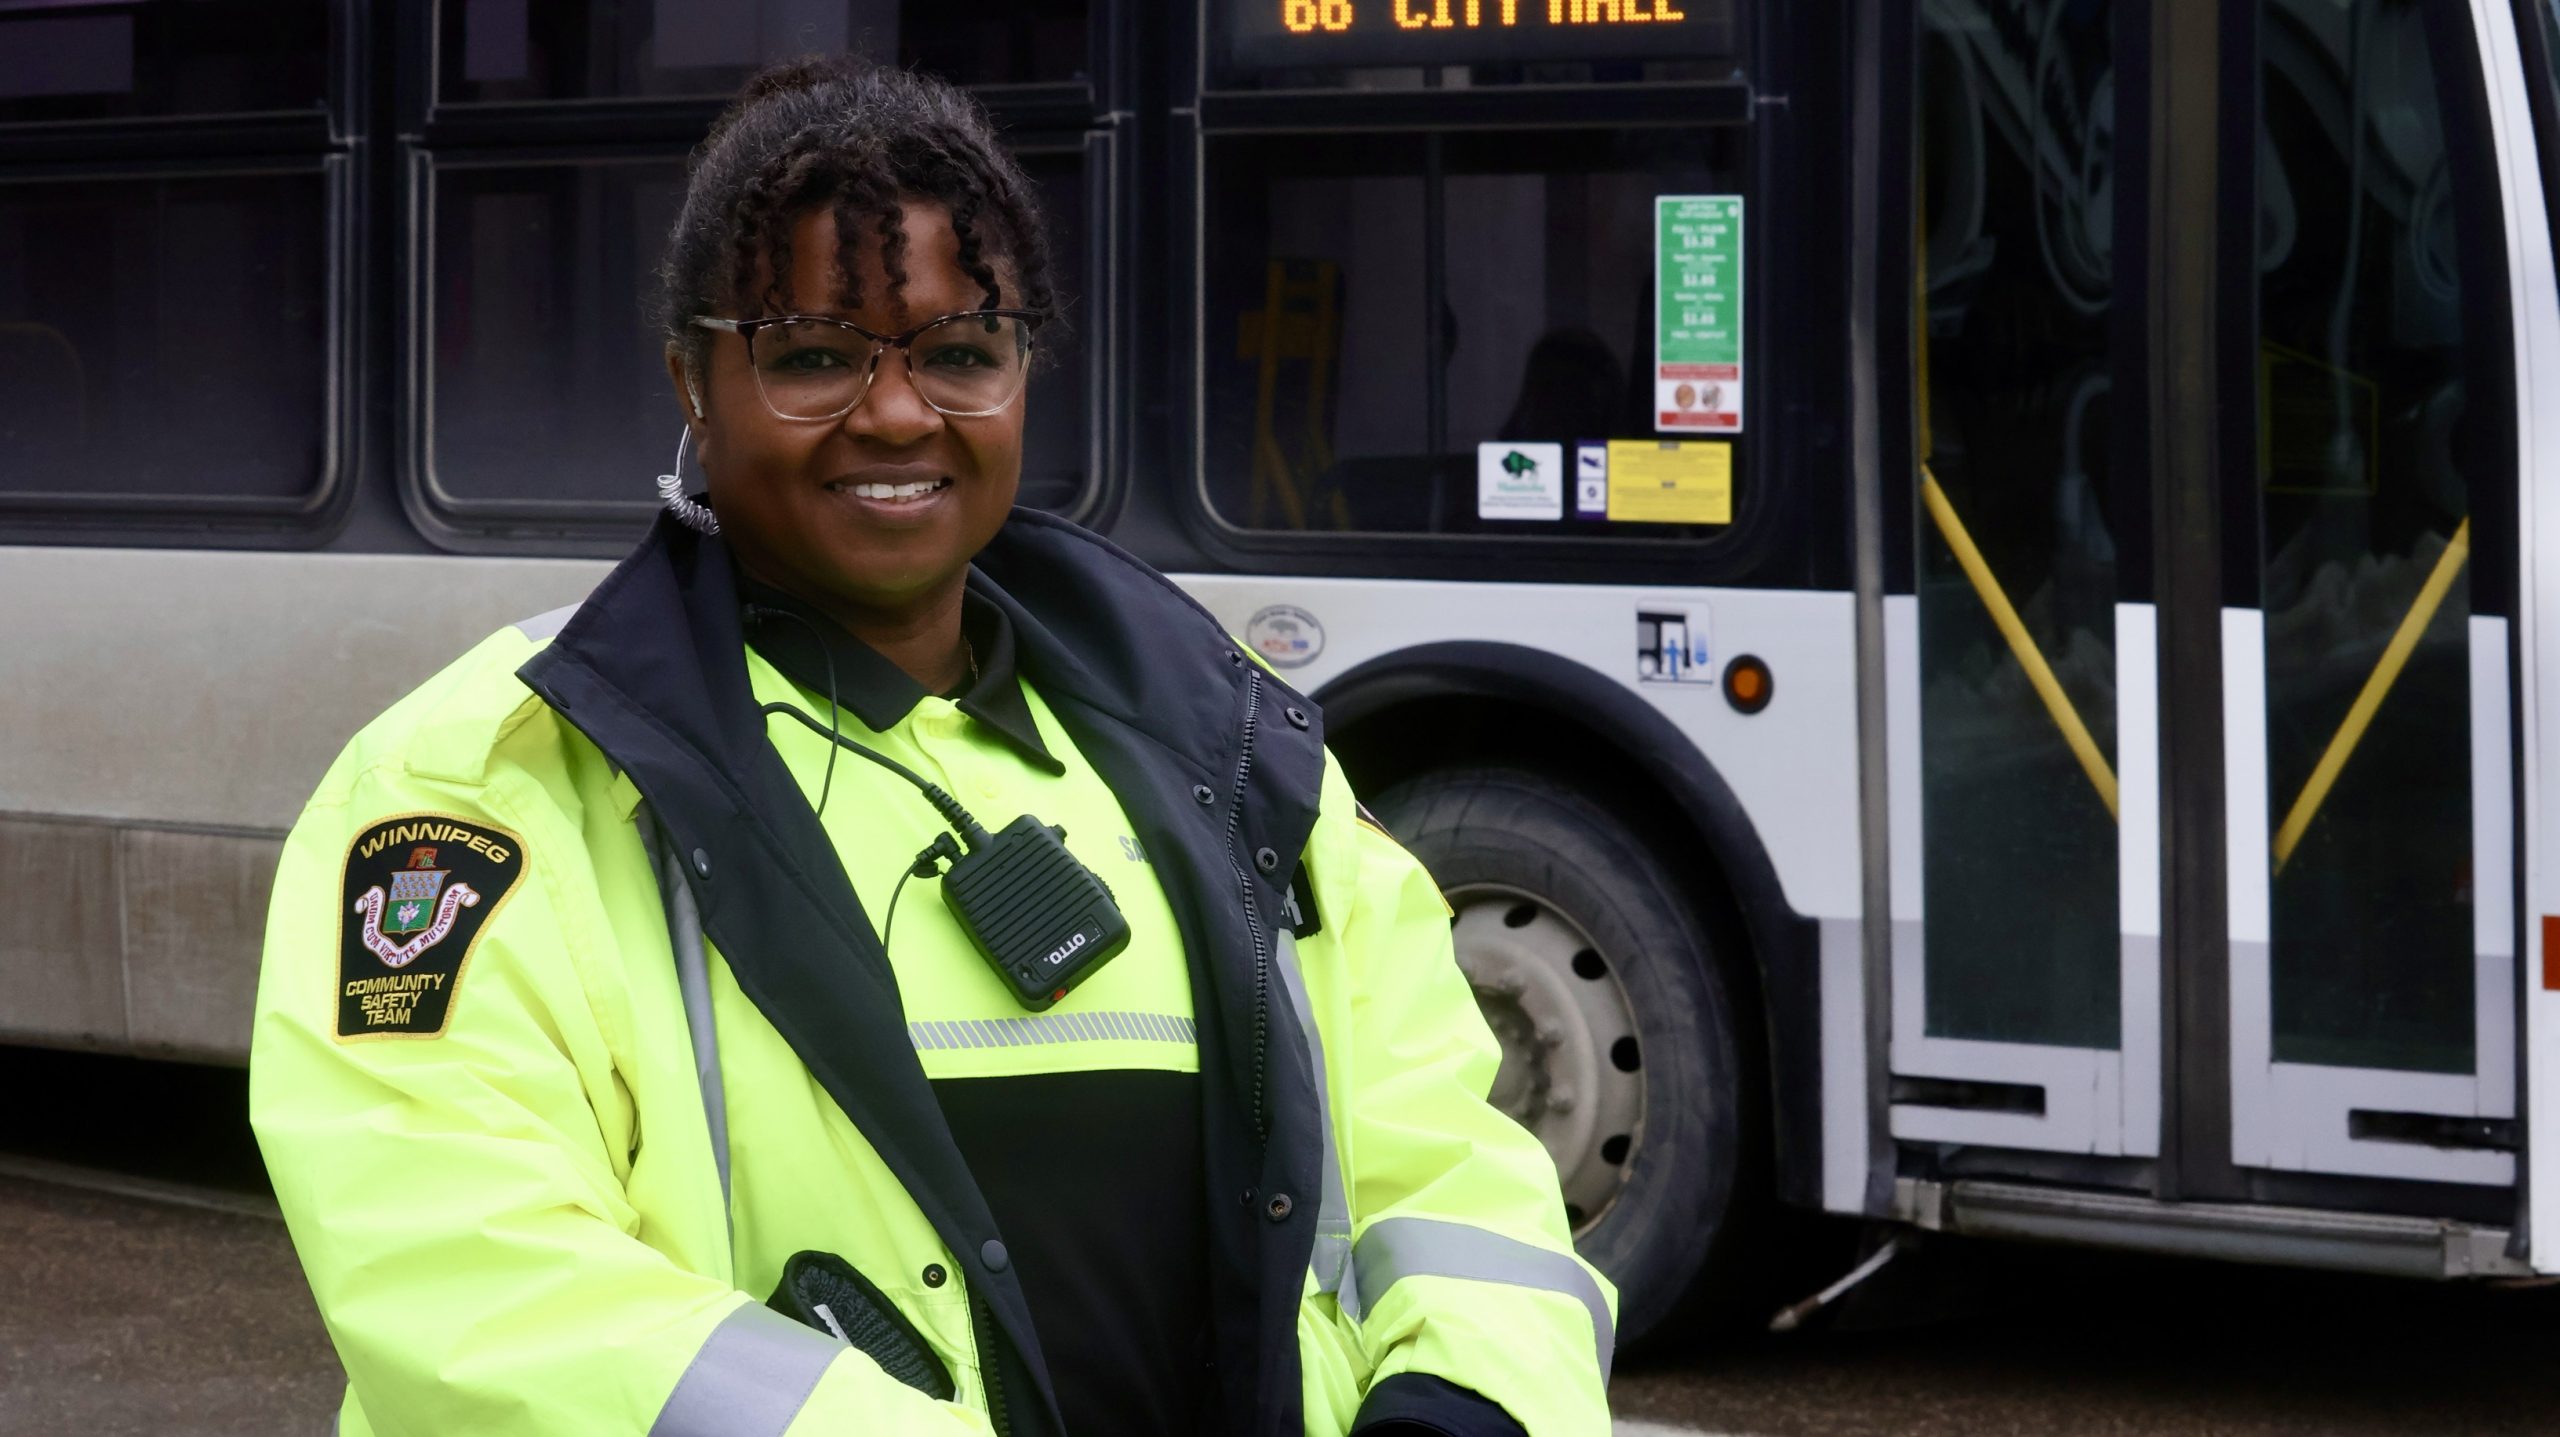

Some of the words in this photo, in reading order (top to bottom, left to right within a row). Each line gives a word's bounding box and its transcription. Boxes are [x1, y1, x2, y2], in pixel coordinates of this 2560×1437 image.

[360, 822, 511, 864] WINNIPEG
[366, 891, 379, 925] UNUM
[419, 888, 461, 948] MULTORUM
[365, 926, 382, 949] CUM
[1048, 932, 1086, 965] OTTO
[345, 973, 446, 997] COMMUNITY
[360, 990, 423, 1011] SAFETY
[365, 1007, 412, 1026] TEAM
